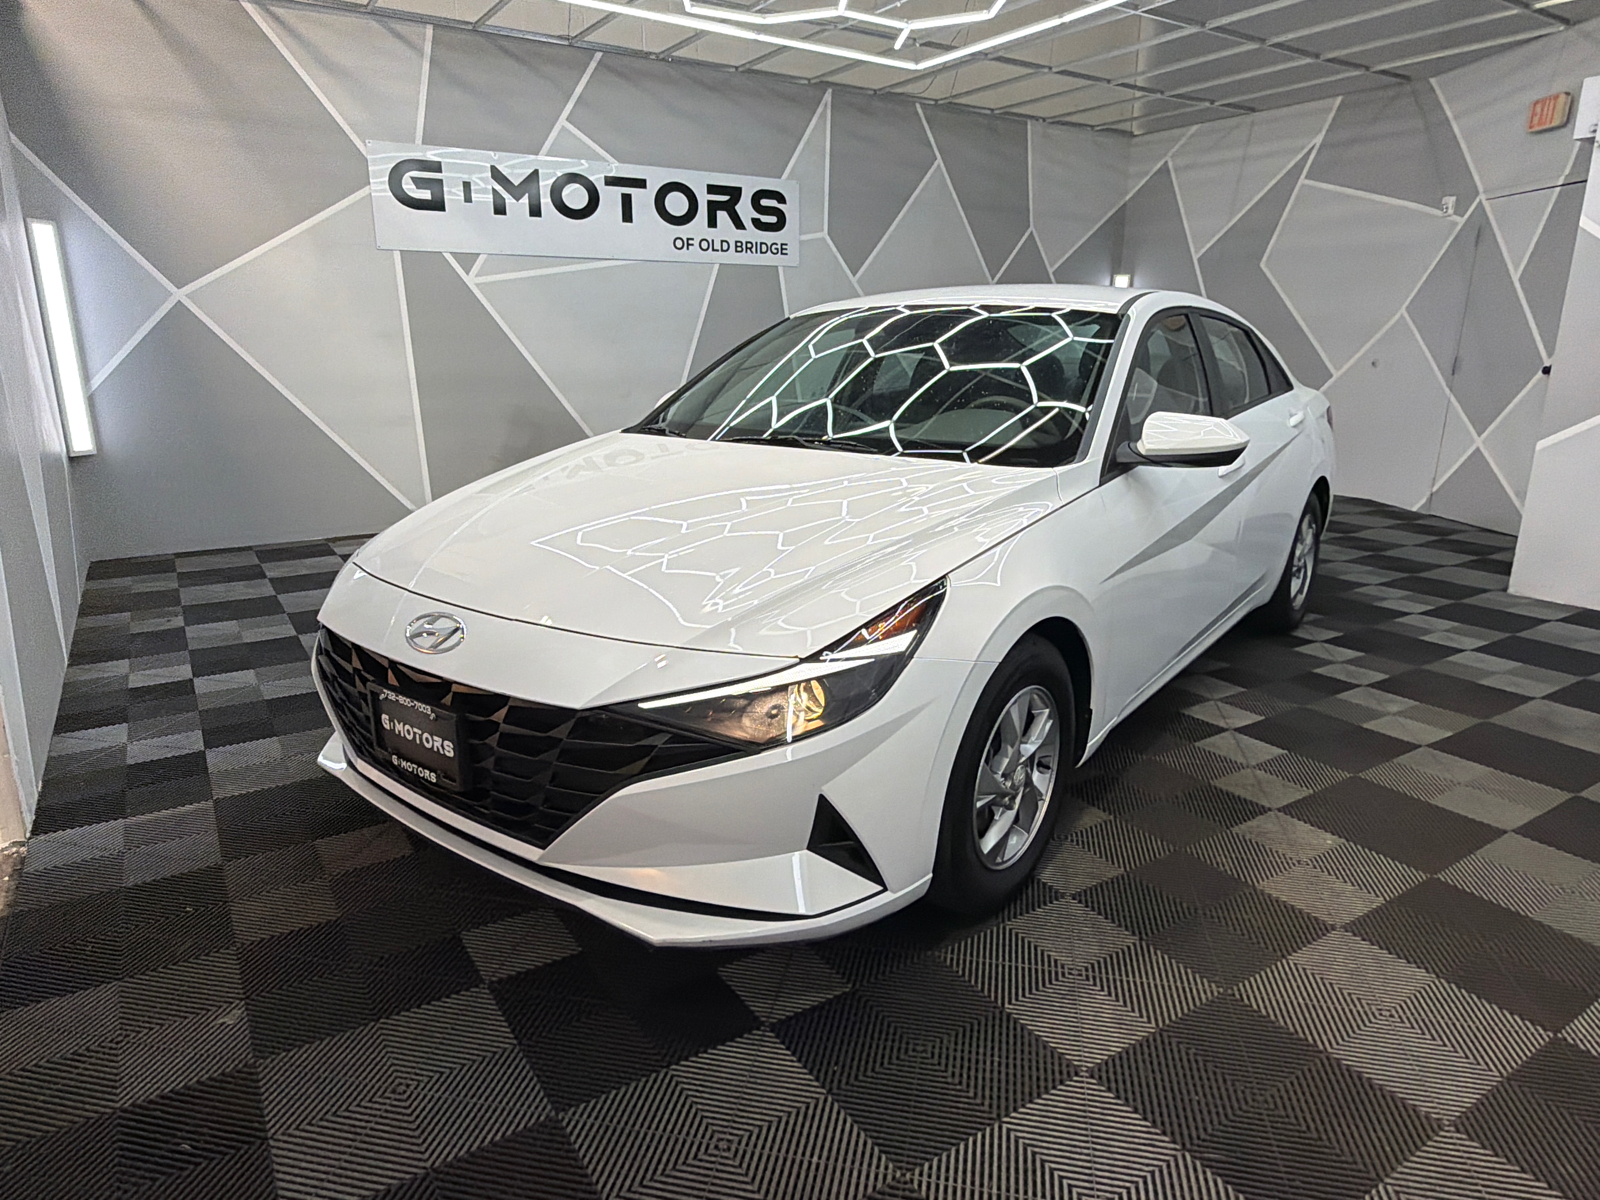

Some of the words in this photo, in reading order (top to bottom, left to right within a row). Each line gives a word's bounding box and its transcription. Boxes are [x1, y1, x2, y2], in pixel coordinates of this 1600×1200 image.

[673, 236, 694, 250] OF
[698, 238, 730, 252] OLD
[734, 240, 788, 256] BRIDGE
